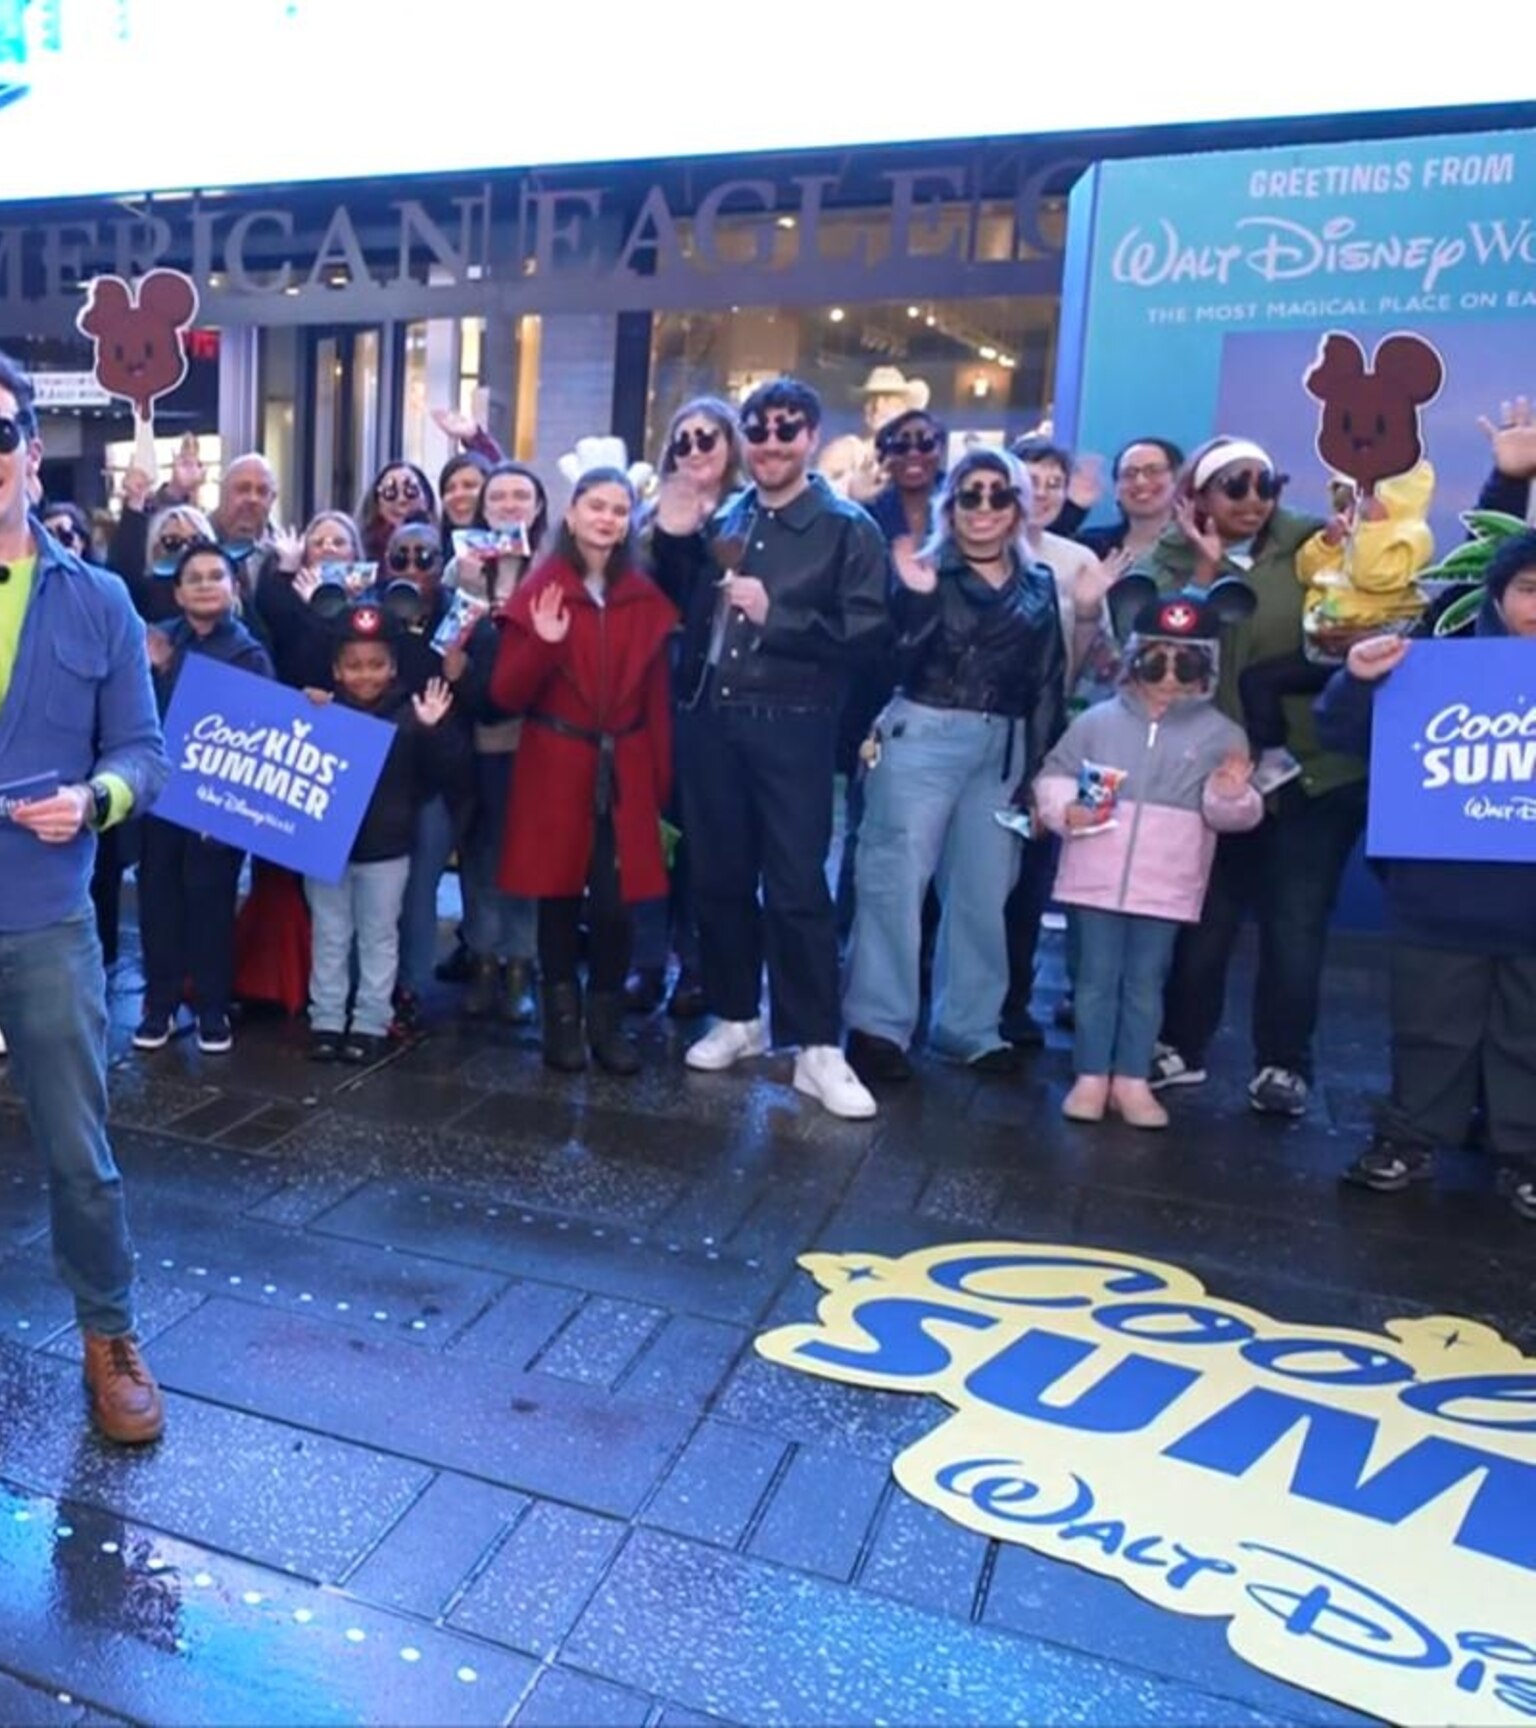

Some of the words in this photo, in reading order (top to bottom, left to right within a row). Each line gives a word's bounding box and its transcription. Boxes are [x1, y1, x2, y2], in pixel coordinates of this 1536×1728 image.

[1249, 161, 1412, 199] GREETINGS
[1422, 153, 1515, 188] FROM
[524, 166, 966, 280] EAGLE
[1147, 305, 1187, 324] THE
[1195, 302, 1257, 321] MOST
[1266, 298, 1367, 318] MAGICAL
[1378, 293, 1451, 312] PLACE
[1459, 291, 1498, 308] ON
[193, 713, 267, 753] Cool
[180, 743, 330, 821] SUMMER
